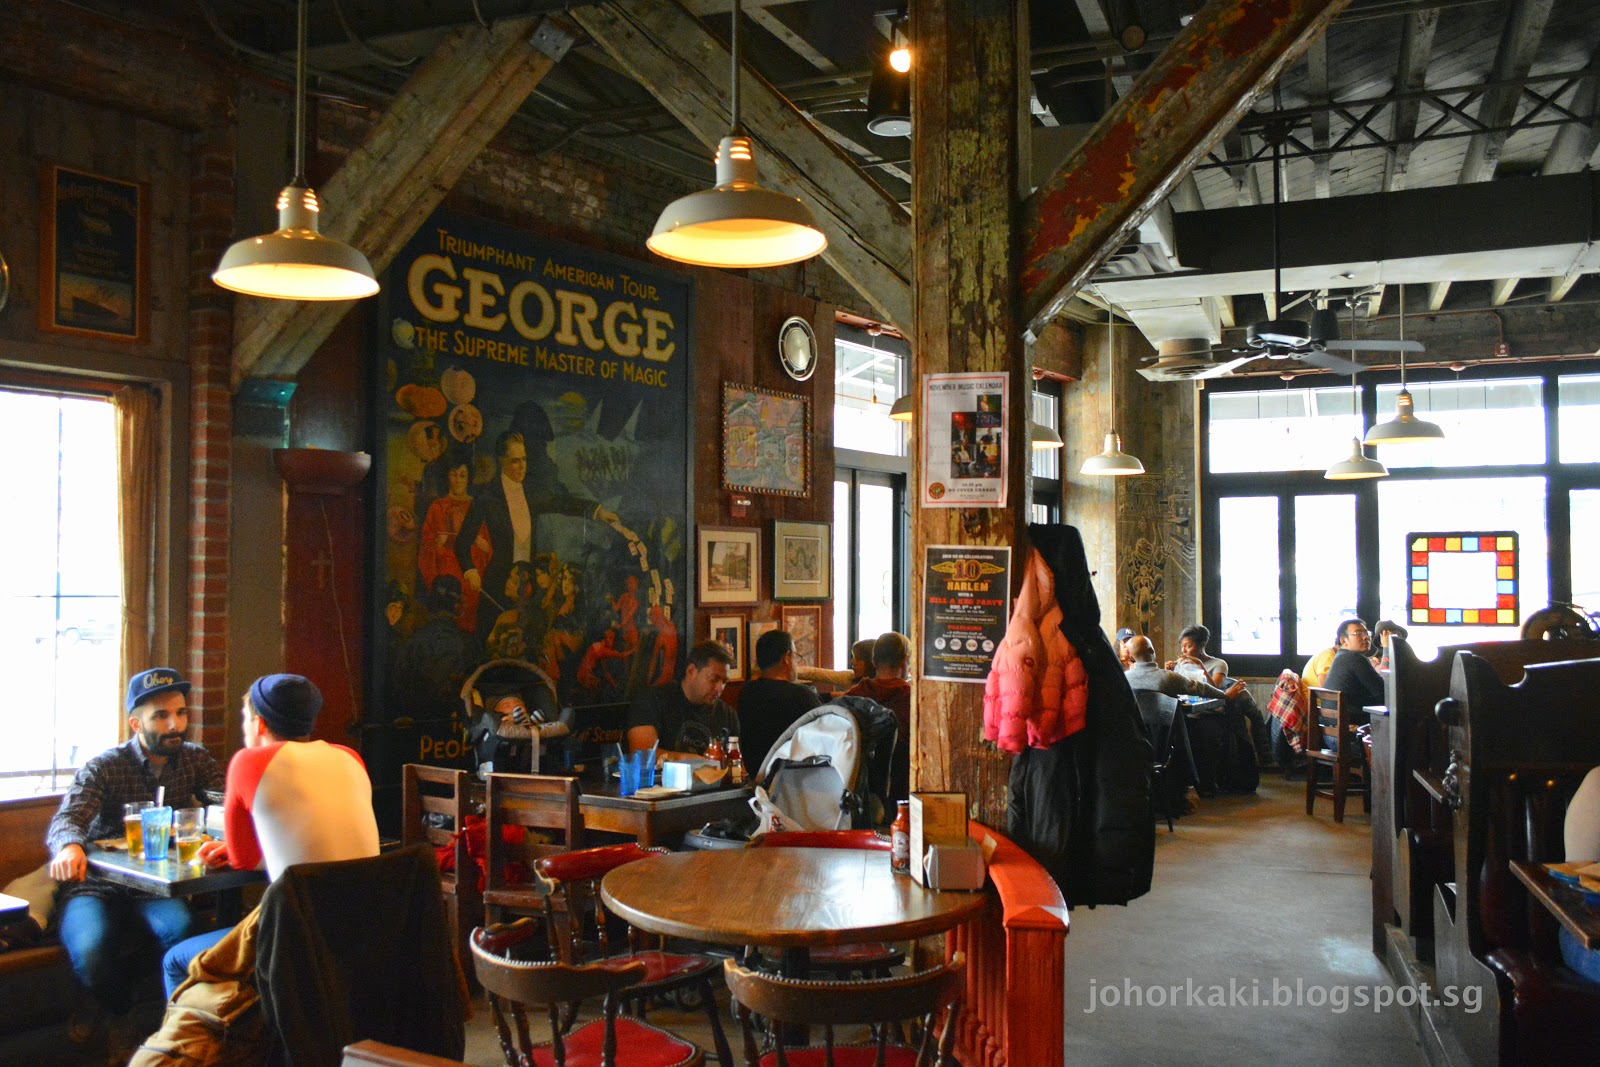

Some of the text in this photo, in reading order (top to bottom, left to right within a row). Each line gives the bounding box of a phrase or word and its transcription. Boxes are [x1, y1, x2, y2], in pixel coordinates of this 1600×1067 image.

[437, 228, 659, 301] TRIUMPHANT AMERICAN TOUR
[407, 253, 676, 363] GEORGE
[415, 327, 668, 388] THE SUPREME MASTER OF MAGIC
[929, 381, 1002, 391] NOVEMBER MUSIC CALENDAR
[947, 581, 989, 592] HARLEM
[952, 559, 983, 581] 10
